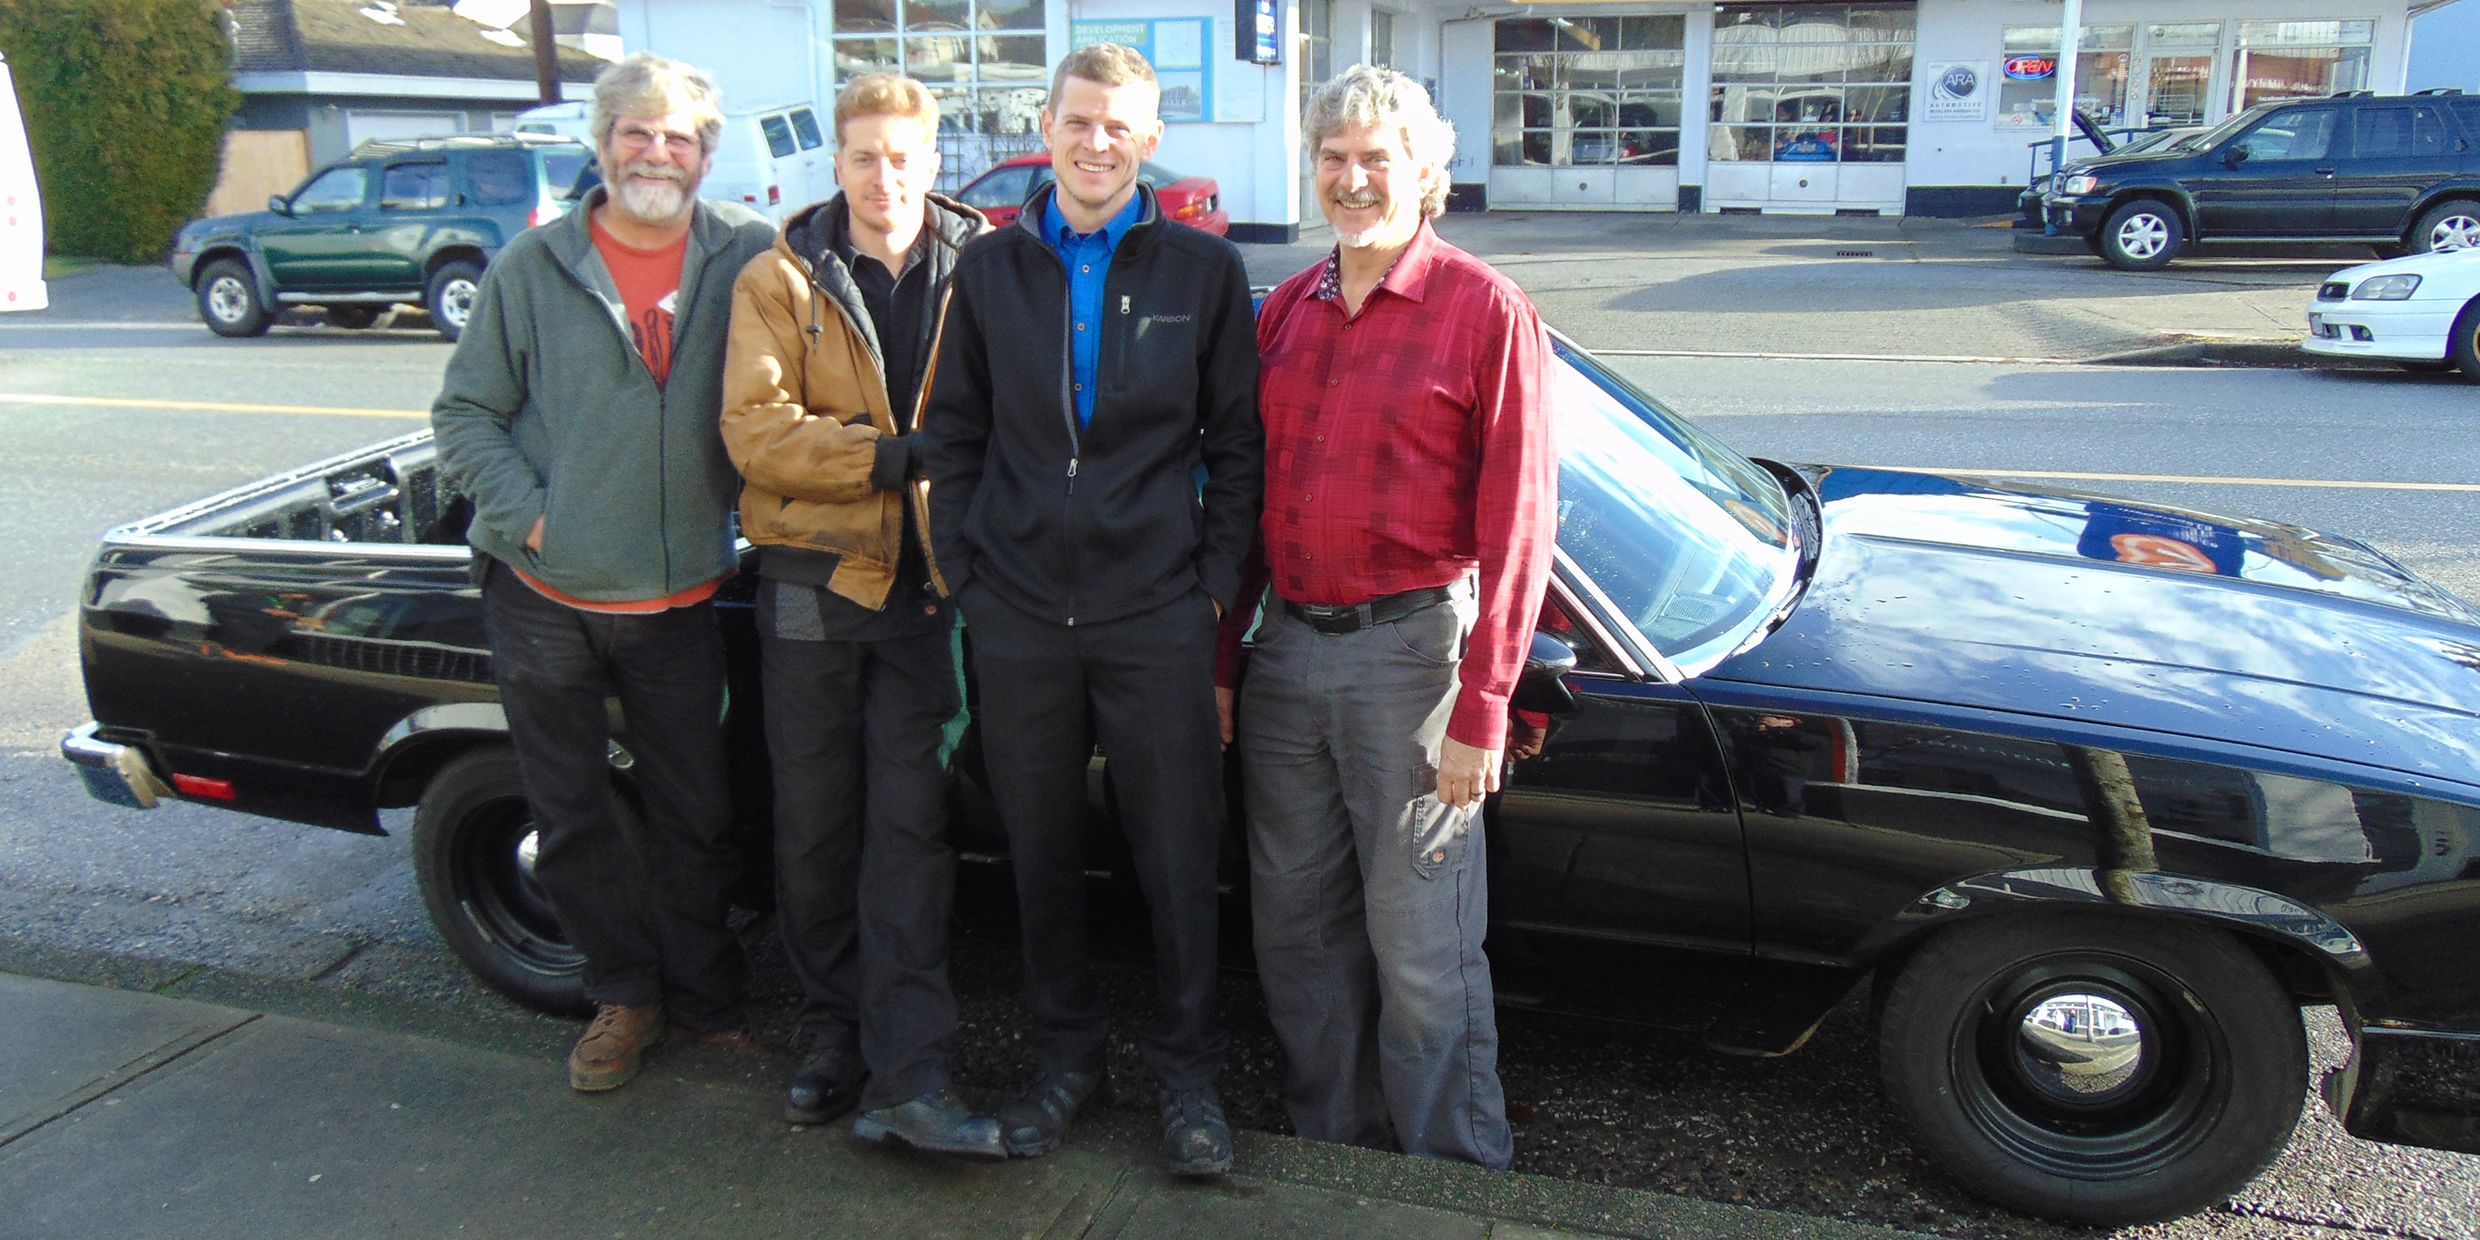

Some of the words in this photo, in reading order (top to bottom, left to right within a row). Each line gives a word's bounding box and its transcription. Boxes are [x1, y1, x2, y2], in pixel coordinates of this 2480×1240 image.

[1075, 24, 1145, 34] DEVELOPMENT
[1075, 34, 1137, 44] APPLICATION
[2007, 60, 2054, 73] OPEN
[1945, 73, 1975, 86] ARA
[1152, 313, 1191, 322] KARBON
